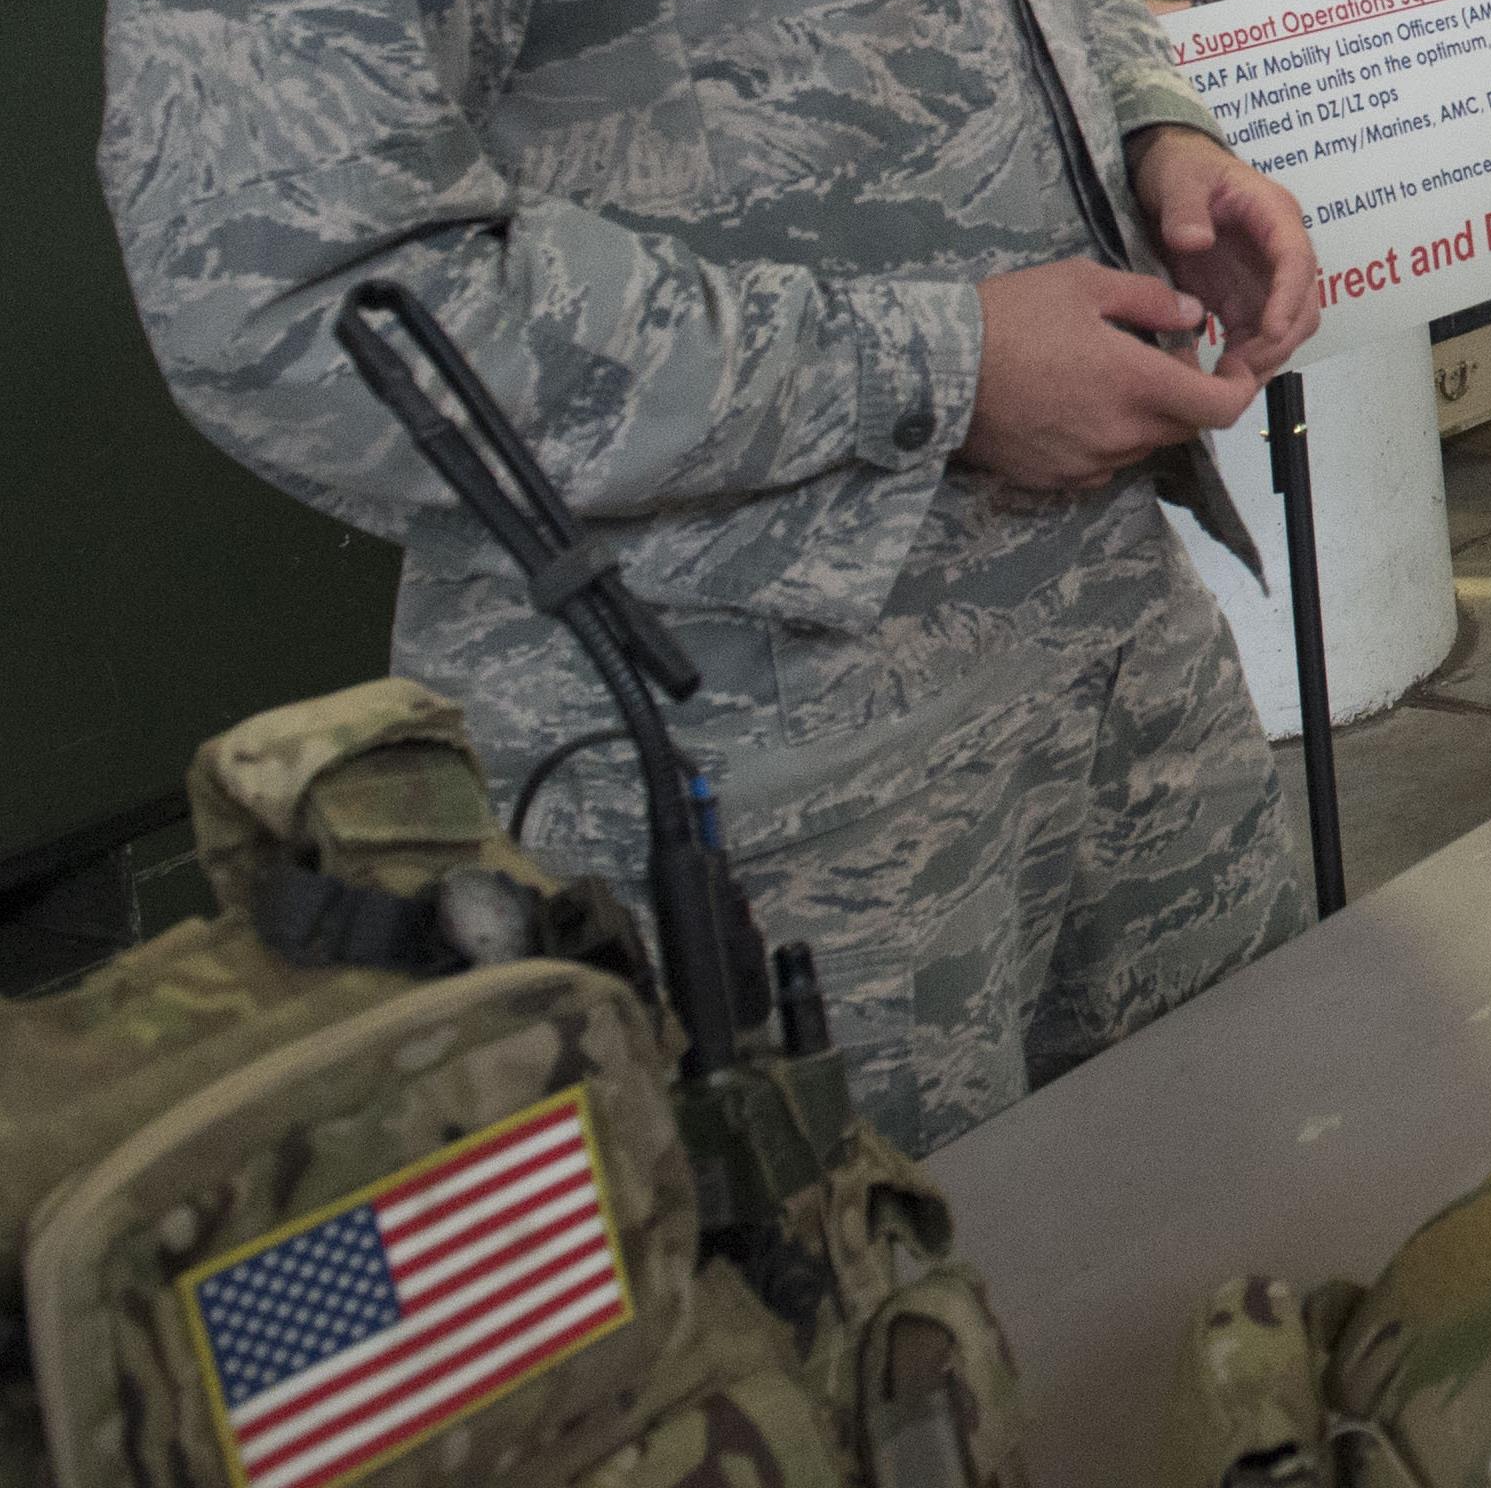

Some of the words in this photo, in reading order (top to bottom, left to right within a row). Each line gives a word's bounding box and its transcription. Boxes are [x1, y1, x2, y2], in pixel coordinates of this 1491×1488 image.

[1189, 69, 1228, 94] SAF
[1236, 62, 1258, 84] Air
[1263, 45, 1331, 72] Mobility
[1336, 28, 1393, 57] Liaison
[1396, 14, 1459, 41] Officers
[1192, 16, 1277, 57] Support
[1317, 67, 1356, 92] units
[1360, 63, 1382, 80] on
[1384, 51, 1412, 75] the
[1416, 34, 1491, 71] optimum,
[1226, 114, 1293, 146] ualified
[1297, 109, 1314, 129] in
[1317, 94, 1365, 123] DZ/LZ
[1368, 87, 1399, 110] ops
[1252, 148, 1309, 175] tween
[1313, 111, 1437, 161] Army/Marines,
[1440, 96, 1485, 123] AMC,
[1317, 182, 1397, 227] DIRLAUTH
[1399, 178, 1418, 200] to
[1317, 247, 1401, 309] irect
[1410, 218, 1476, 277] and
